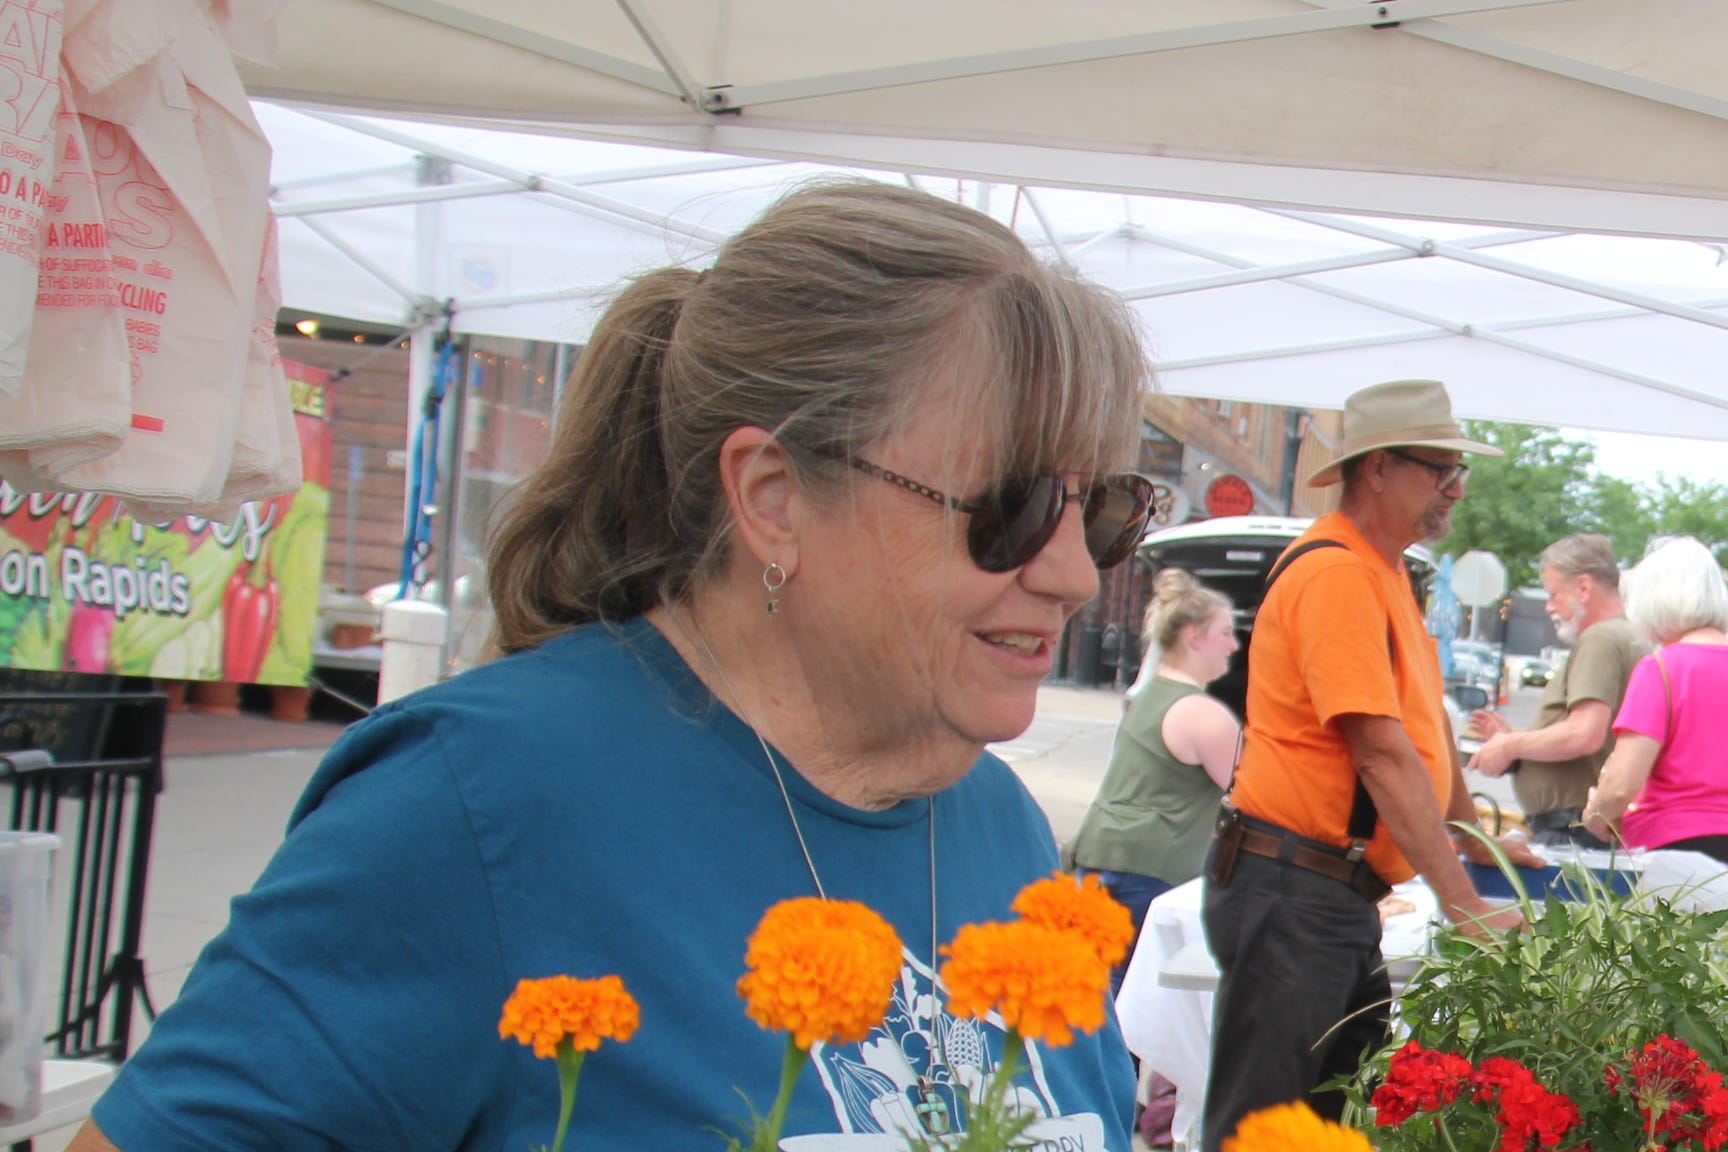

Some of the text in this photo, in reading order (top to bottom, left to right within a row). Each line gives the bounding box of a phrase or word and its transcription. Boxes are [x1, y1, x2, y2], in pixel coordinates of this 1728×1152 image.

[48, 222, 60, 247] A
[125, 318, 161, 338] BABIES
[137, 337, 159, 354] BAG
[61, 547, 191, 618] Rapids
